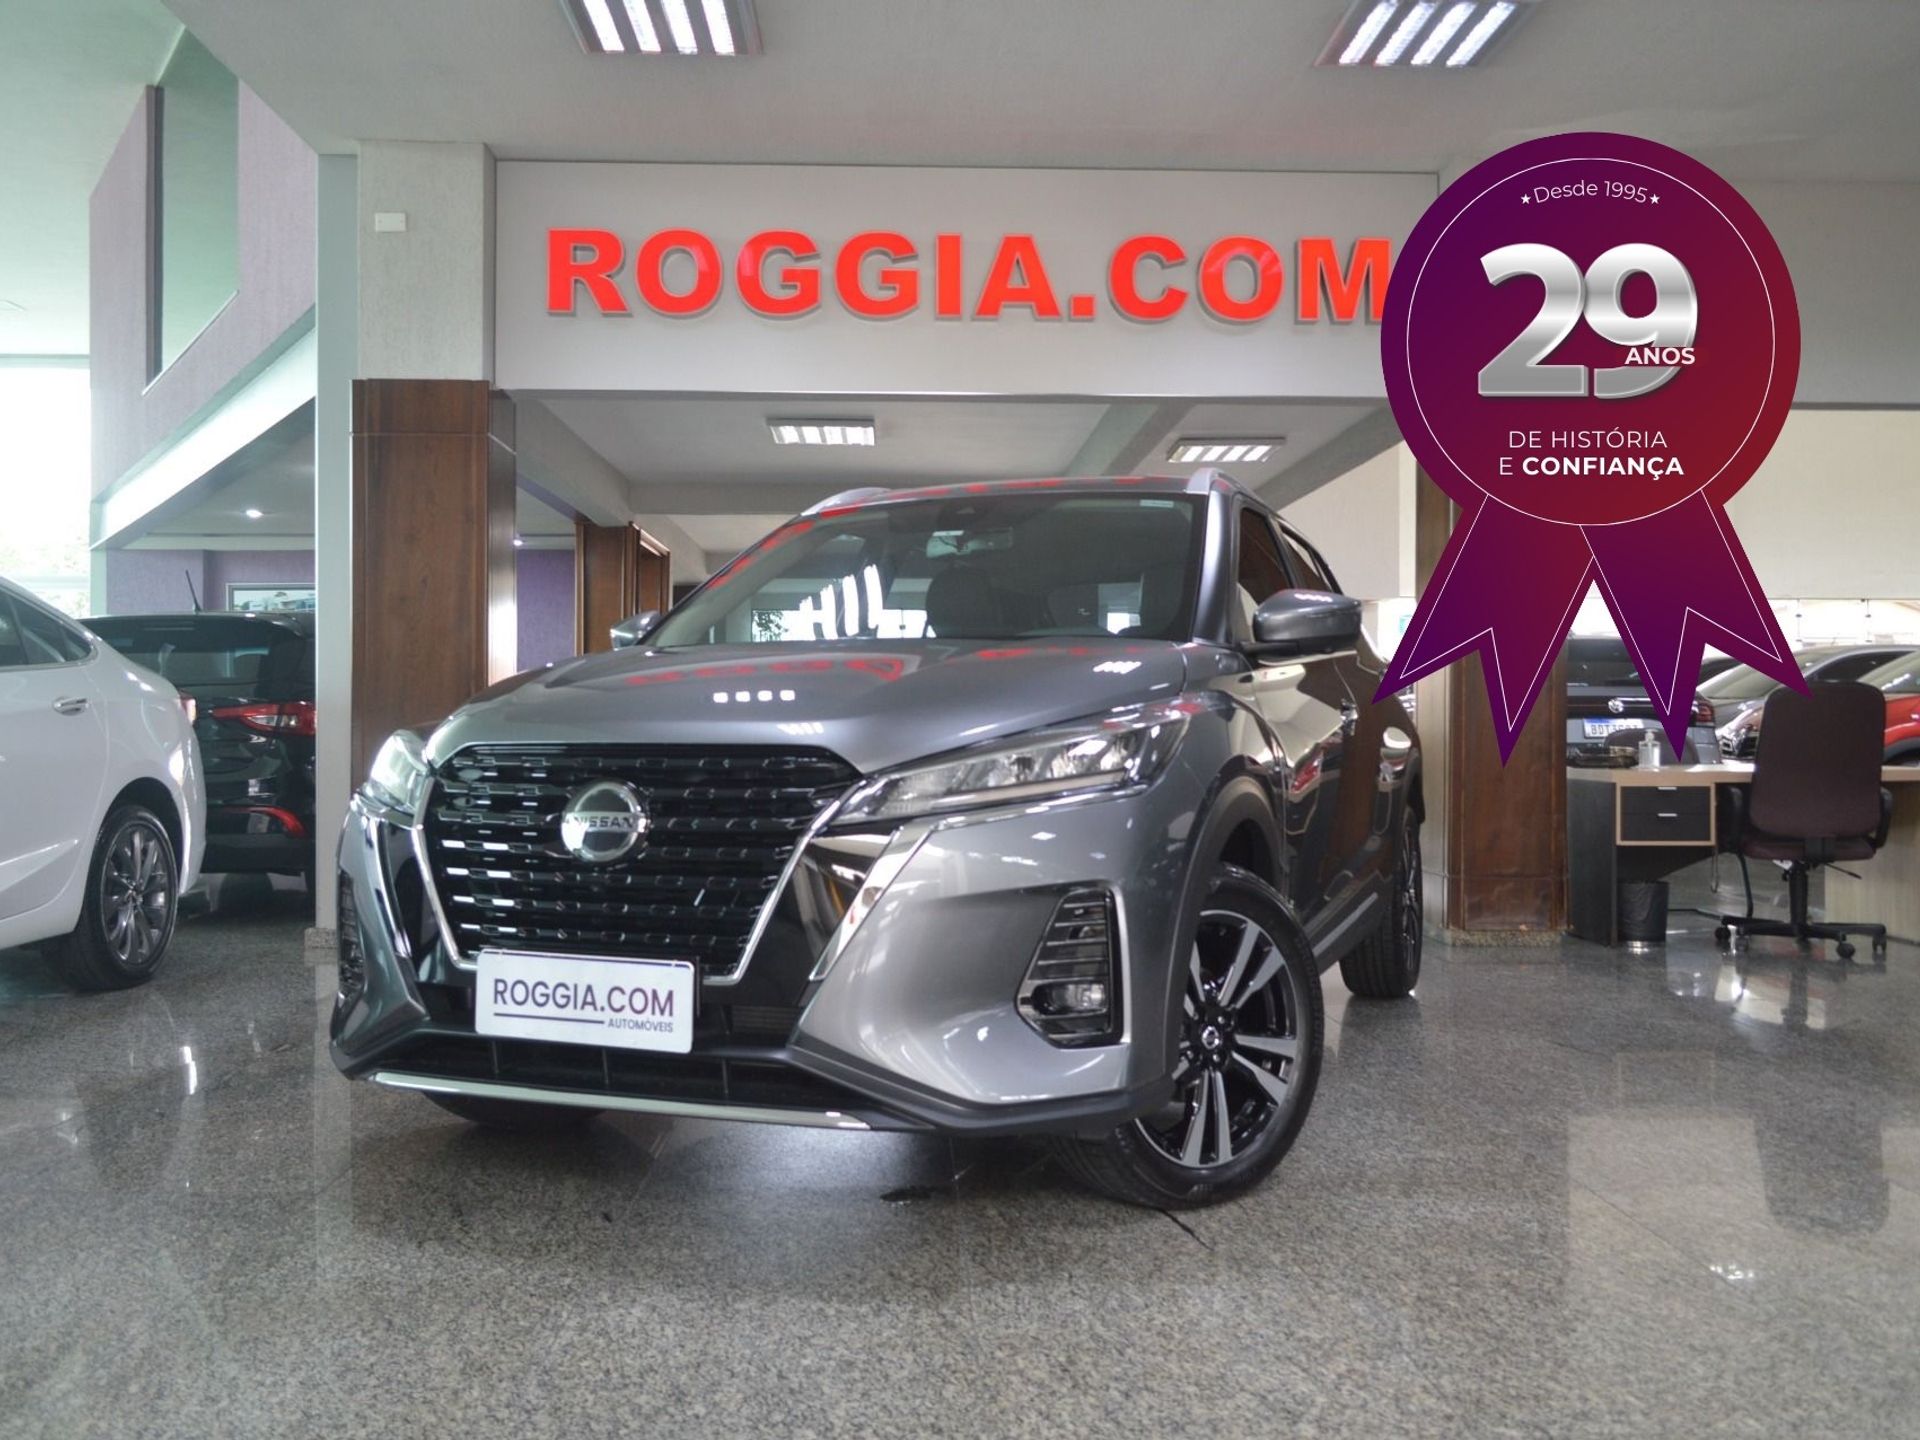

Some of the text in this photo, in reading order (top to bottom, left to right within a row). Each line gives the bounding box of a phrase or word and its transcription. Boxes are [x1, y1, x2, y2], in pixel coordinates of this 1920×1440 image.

[547, 228, 1391, 322] ROGGIA.COM
[573, 816, 633, 828] NISSAN
[494, 978, 674, 1017] ROGGIA.COM
[607, 1017, 674, 1033] AUTOMÓVEIS
